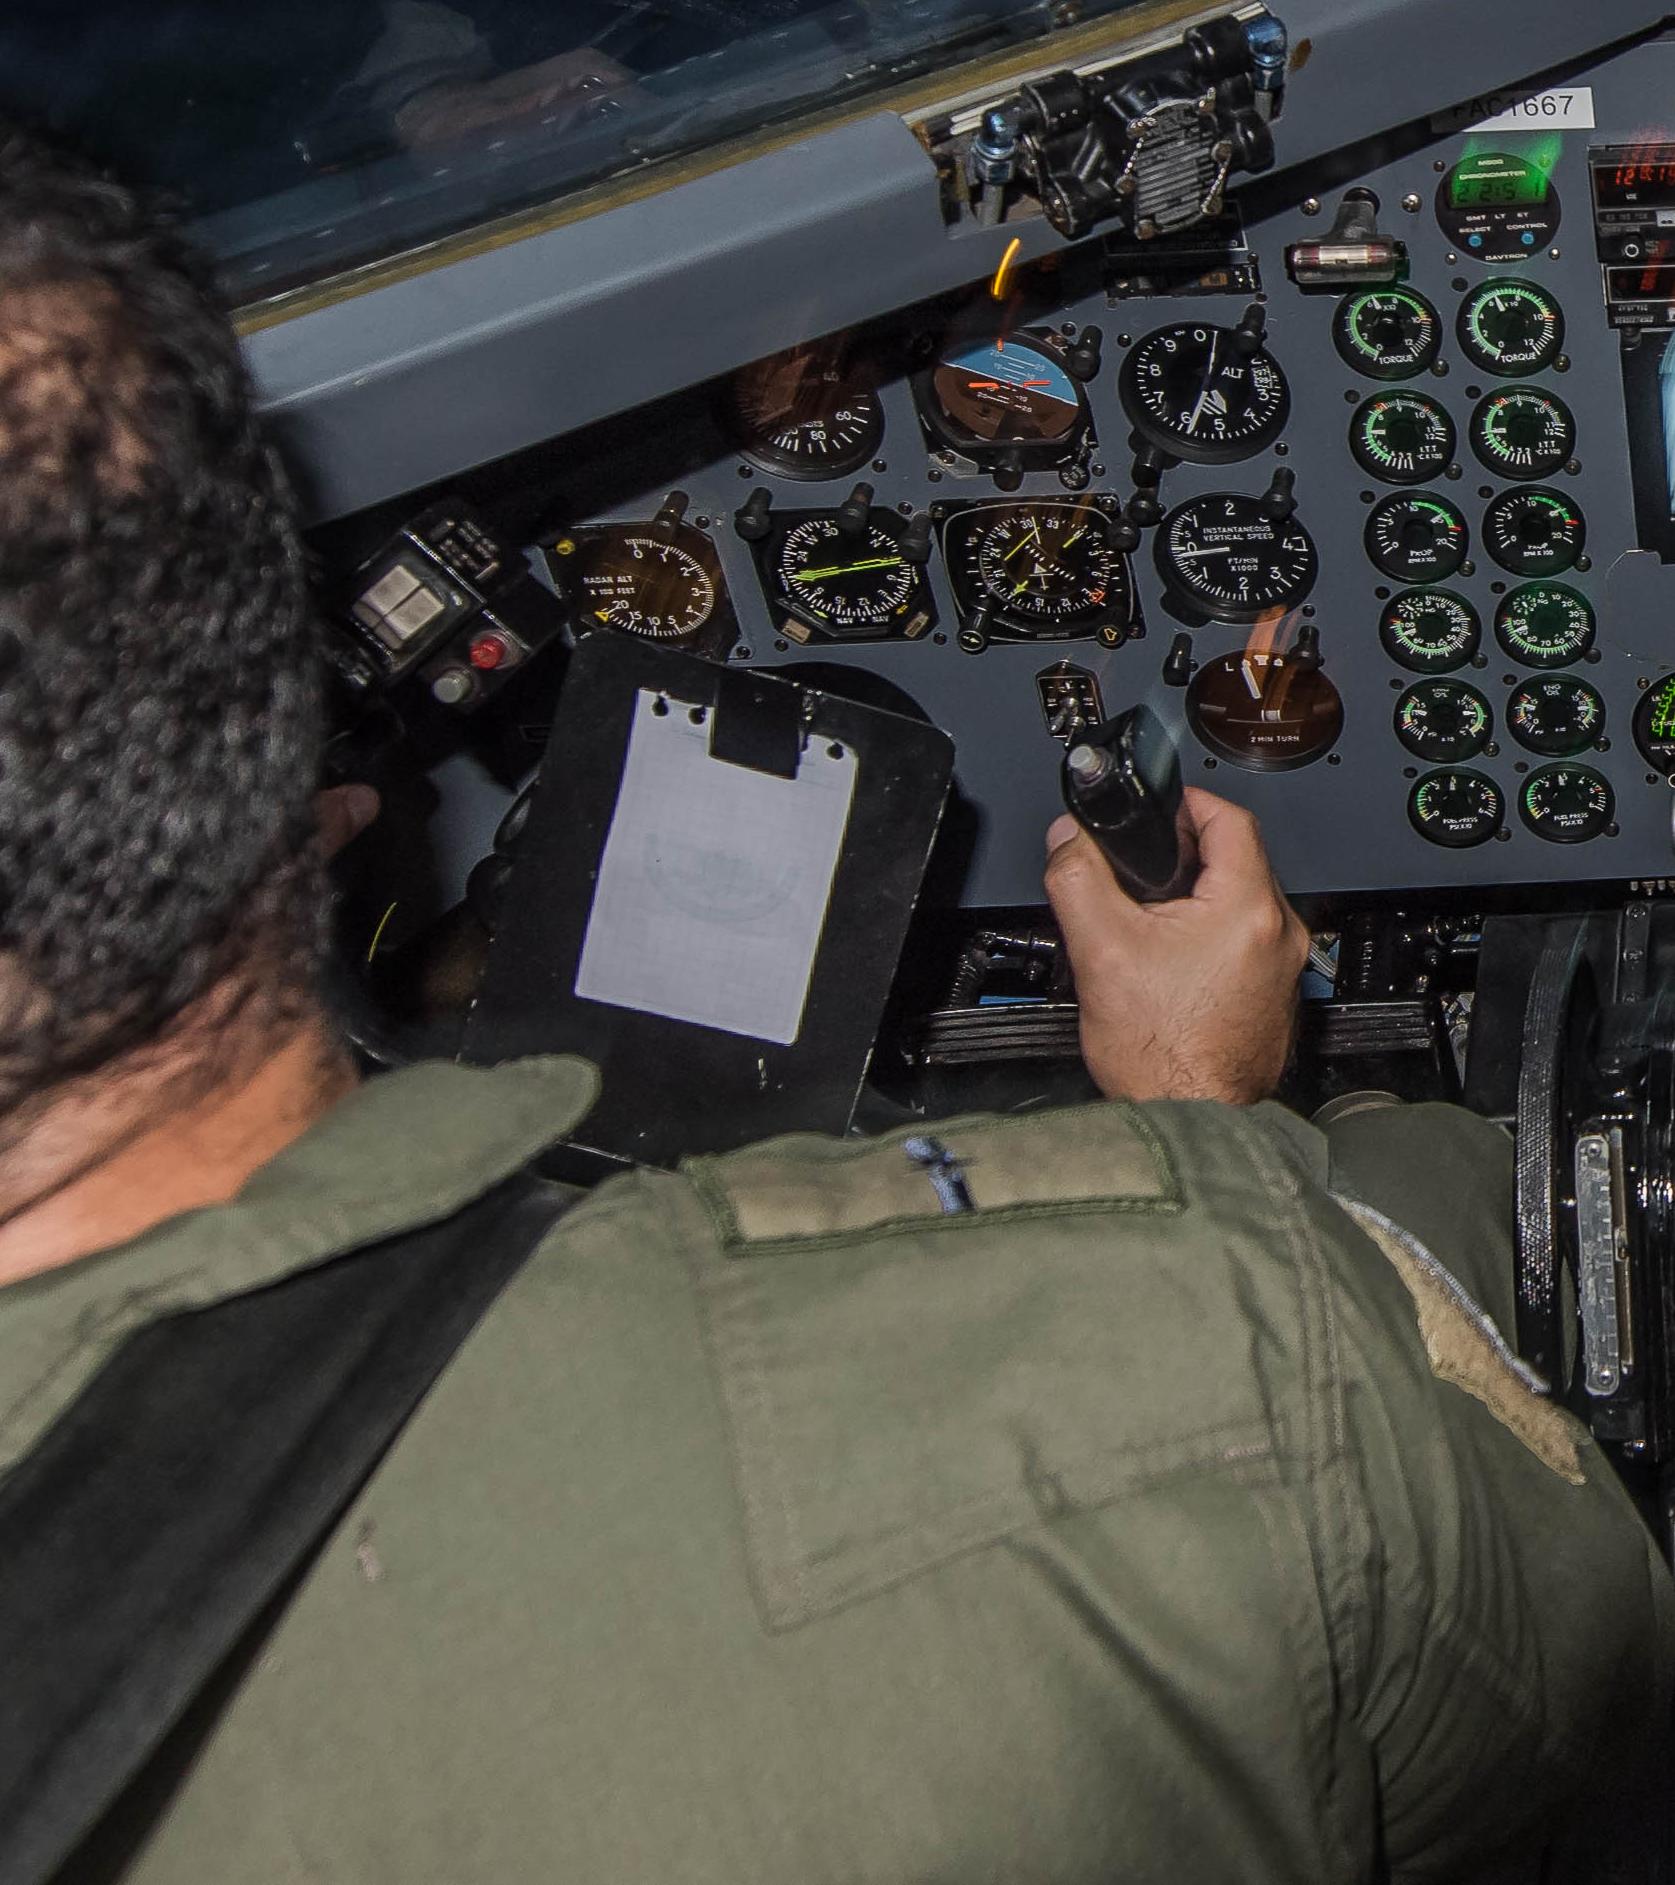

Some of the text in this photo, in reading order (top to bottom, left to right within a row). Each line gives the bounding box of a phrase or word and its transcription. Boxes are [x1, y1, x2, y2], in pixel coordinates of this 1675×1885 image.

[1466, 214, 1486, 222] GMT
[1459, 225, 1492, 233] SELECT
[1506, 222, 1548, 231] CONTROL
[1485, 253, 1528, 261] DAVTRON
[1533, 313, 1543, 321] 10
[1193, 329, 1207, 342] 0
[1164, 339, 1177, 352] 9
[1378, 354, 1415, 365] TORQUE
[1500, 352, 1537, 364] TORQUE
[1150, 364, 1162, 377] 8
[1222, 366, 1245, 380] ALT
[1153, 391, 1165, 404] 7
[1258, 388, 1269, 402] 3
[835, 411, 852, 421] 60
[1214, 418, 1225, 431] 5
[810, 430, 826, 441] 80
[1225, 502, 1236, 516] 2
[1046, 518, 1059, 530] 33
[824, 527, 839, 538] 30
[1203, 525, 1271, 535] INSTANTANEOUS
[1203, 532, 1275, 542] VERTICAL SPEED
[1227, 556, 1259, 565] FT/MIN
[583, 575, 633, 584] RADAR ALT
[614, 599, 629, 610] 20
[628, 610, 643, 621] 15
[646, 616, 660, 627] 10
